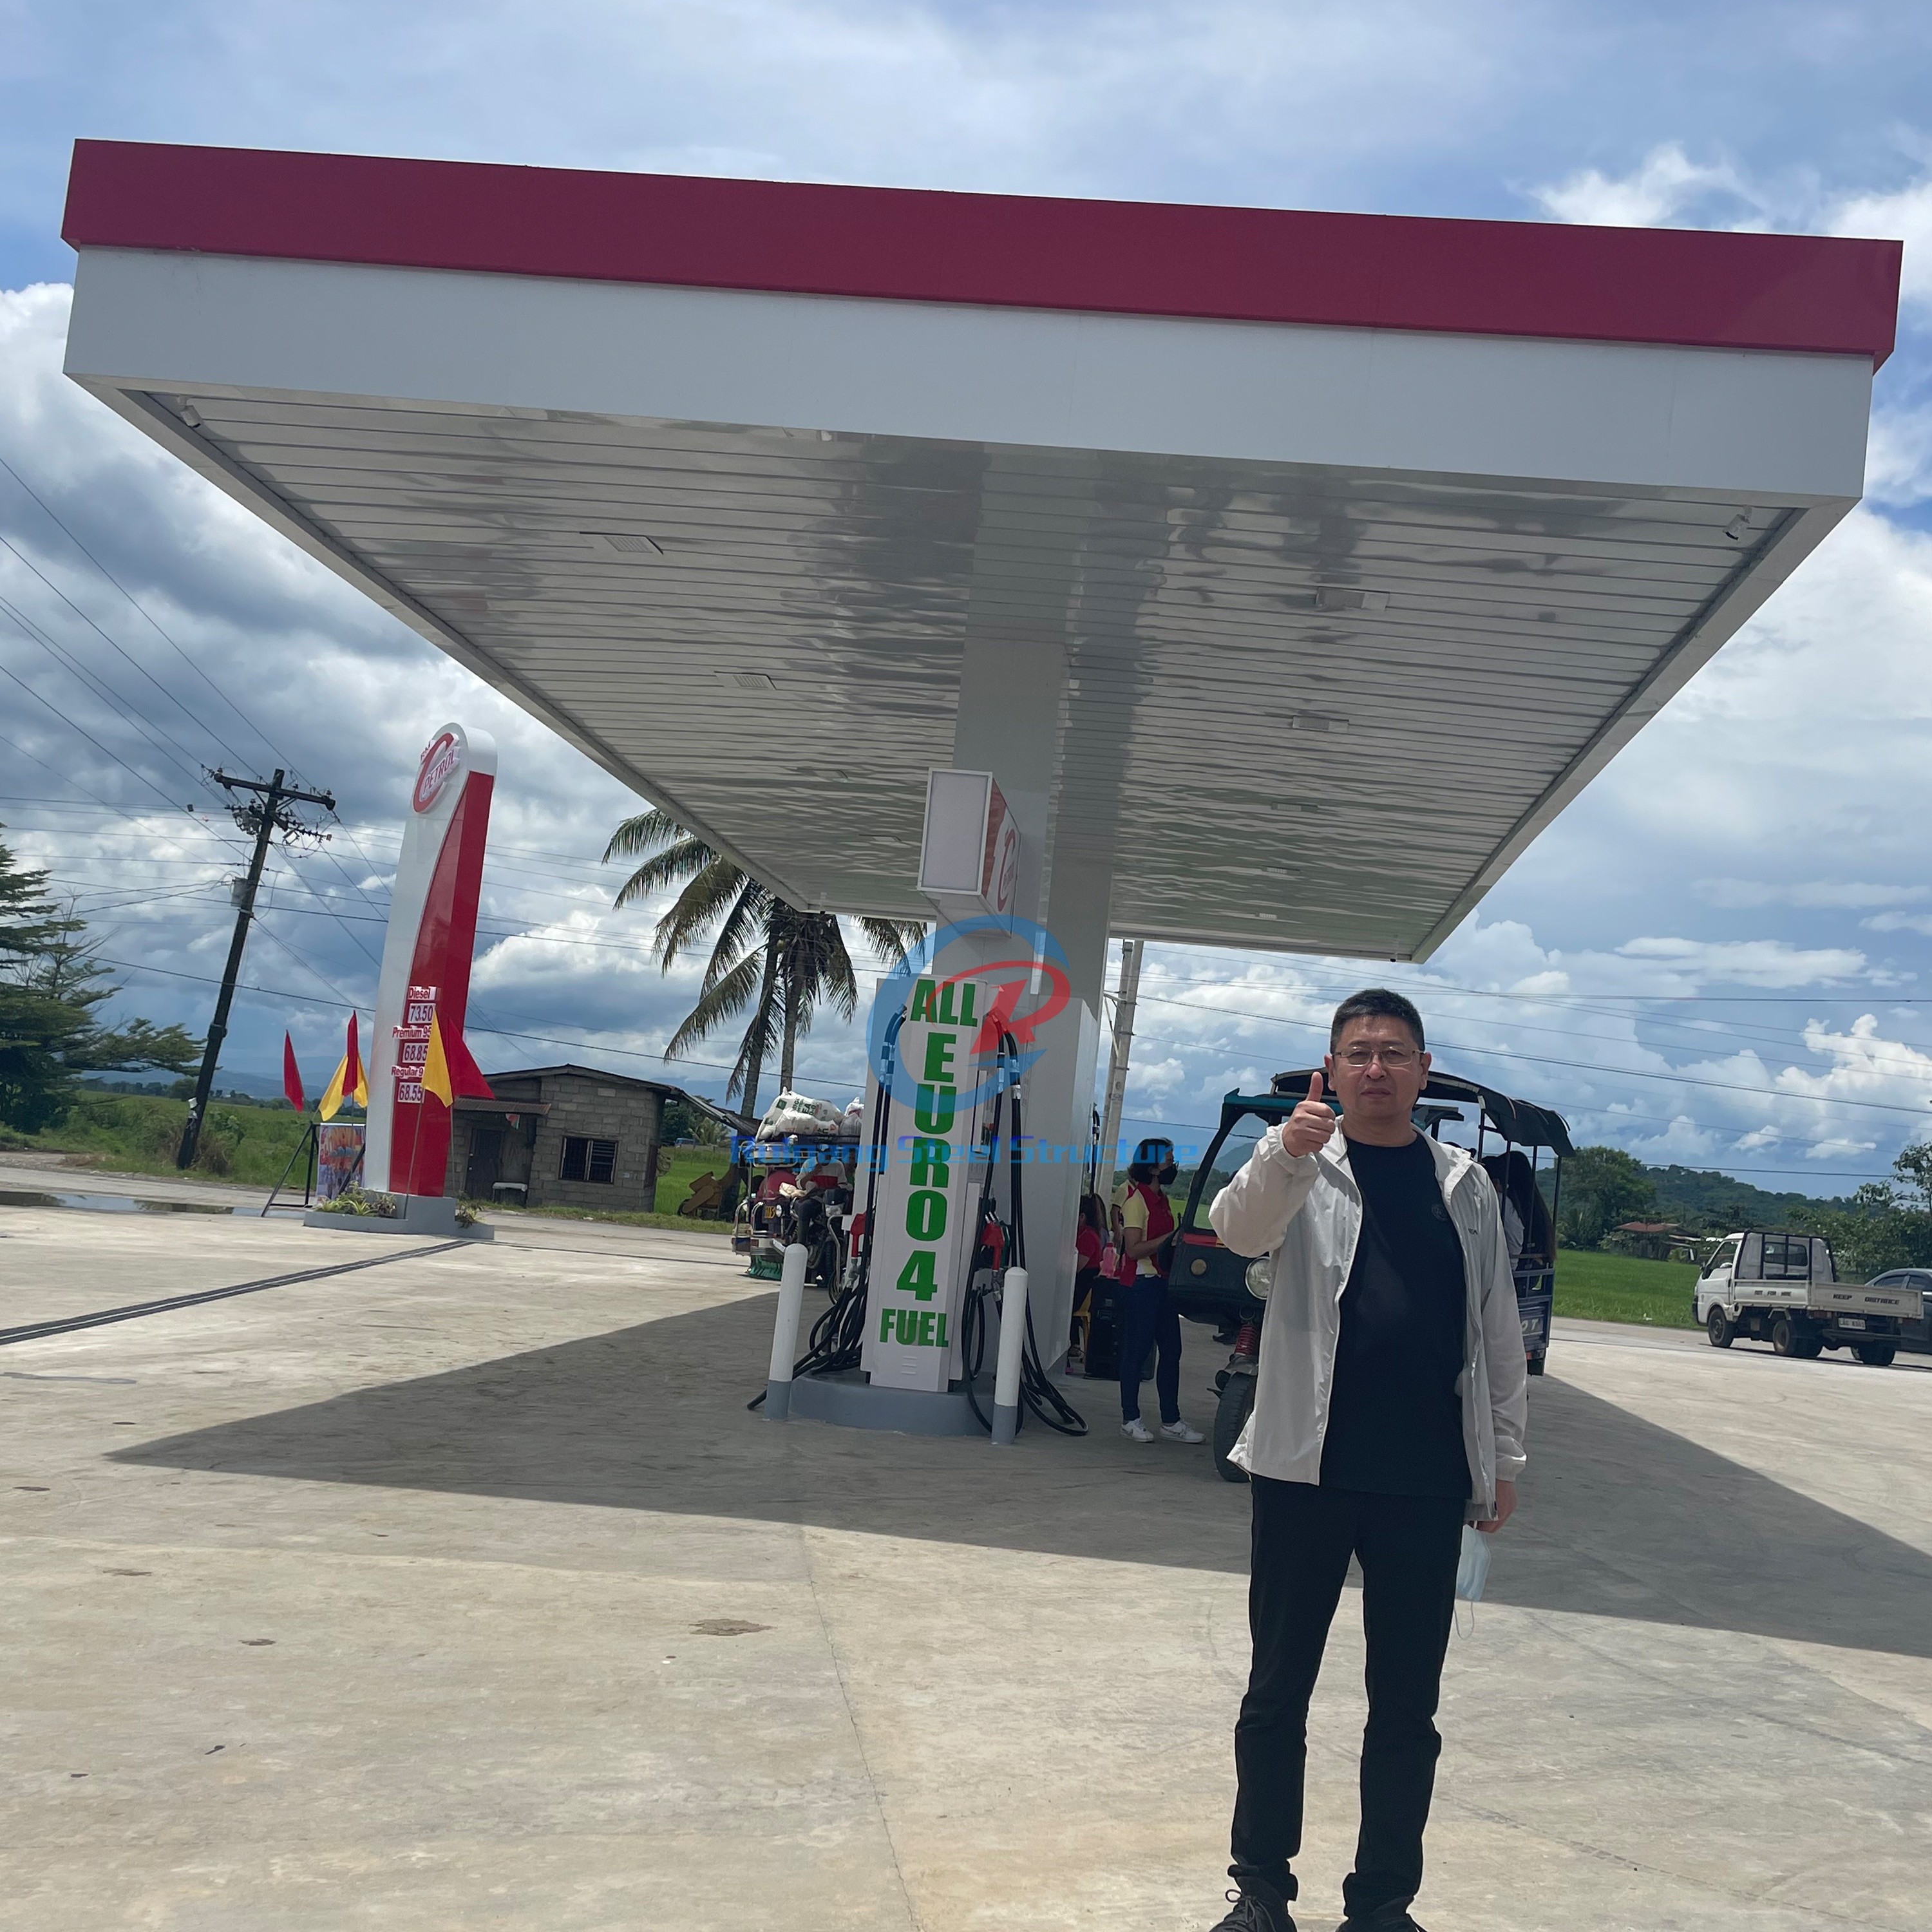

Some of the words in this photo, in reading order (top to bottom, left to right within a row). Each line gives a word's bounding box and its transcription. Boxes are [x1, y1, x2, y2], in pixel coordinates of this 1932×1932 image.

[422, 749, 455, 795] PETROL
[408, 987, 431, 999] Diesel
[910, 979, 978, 1028] ALL
[410, 1005, 433, 1022] 73.50
[392, 1027, 422, 1038] Premium
[404, 1045, 428, 1061] 68.85
[392, 1066, 418, 1078] Regular
[399, 1084, 422, 1101] 68.55
[880, 1308, 949, 1348] FUEL
